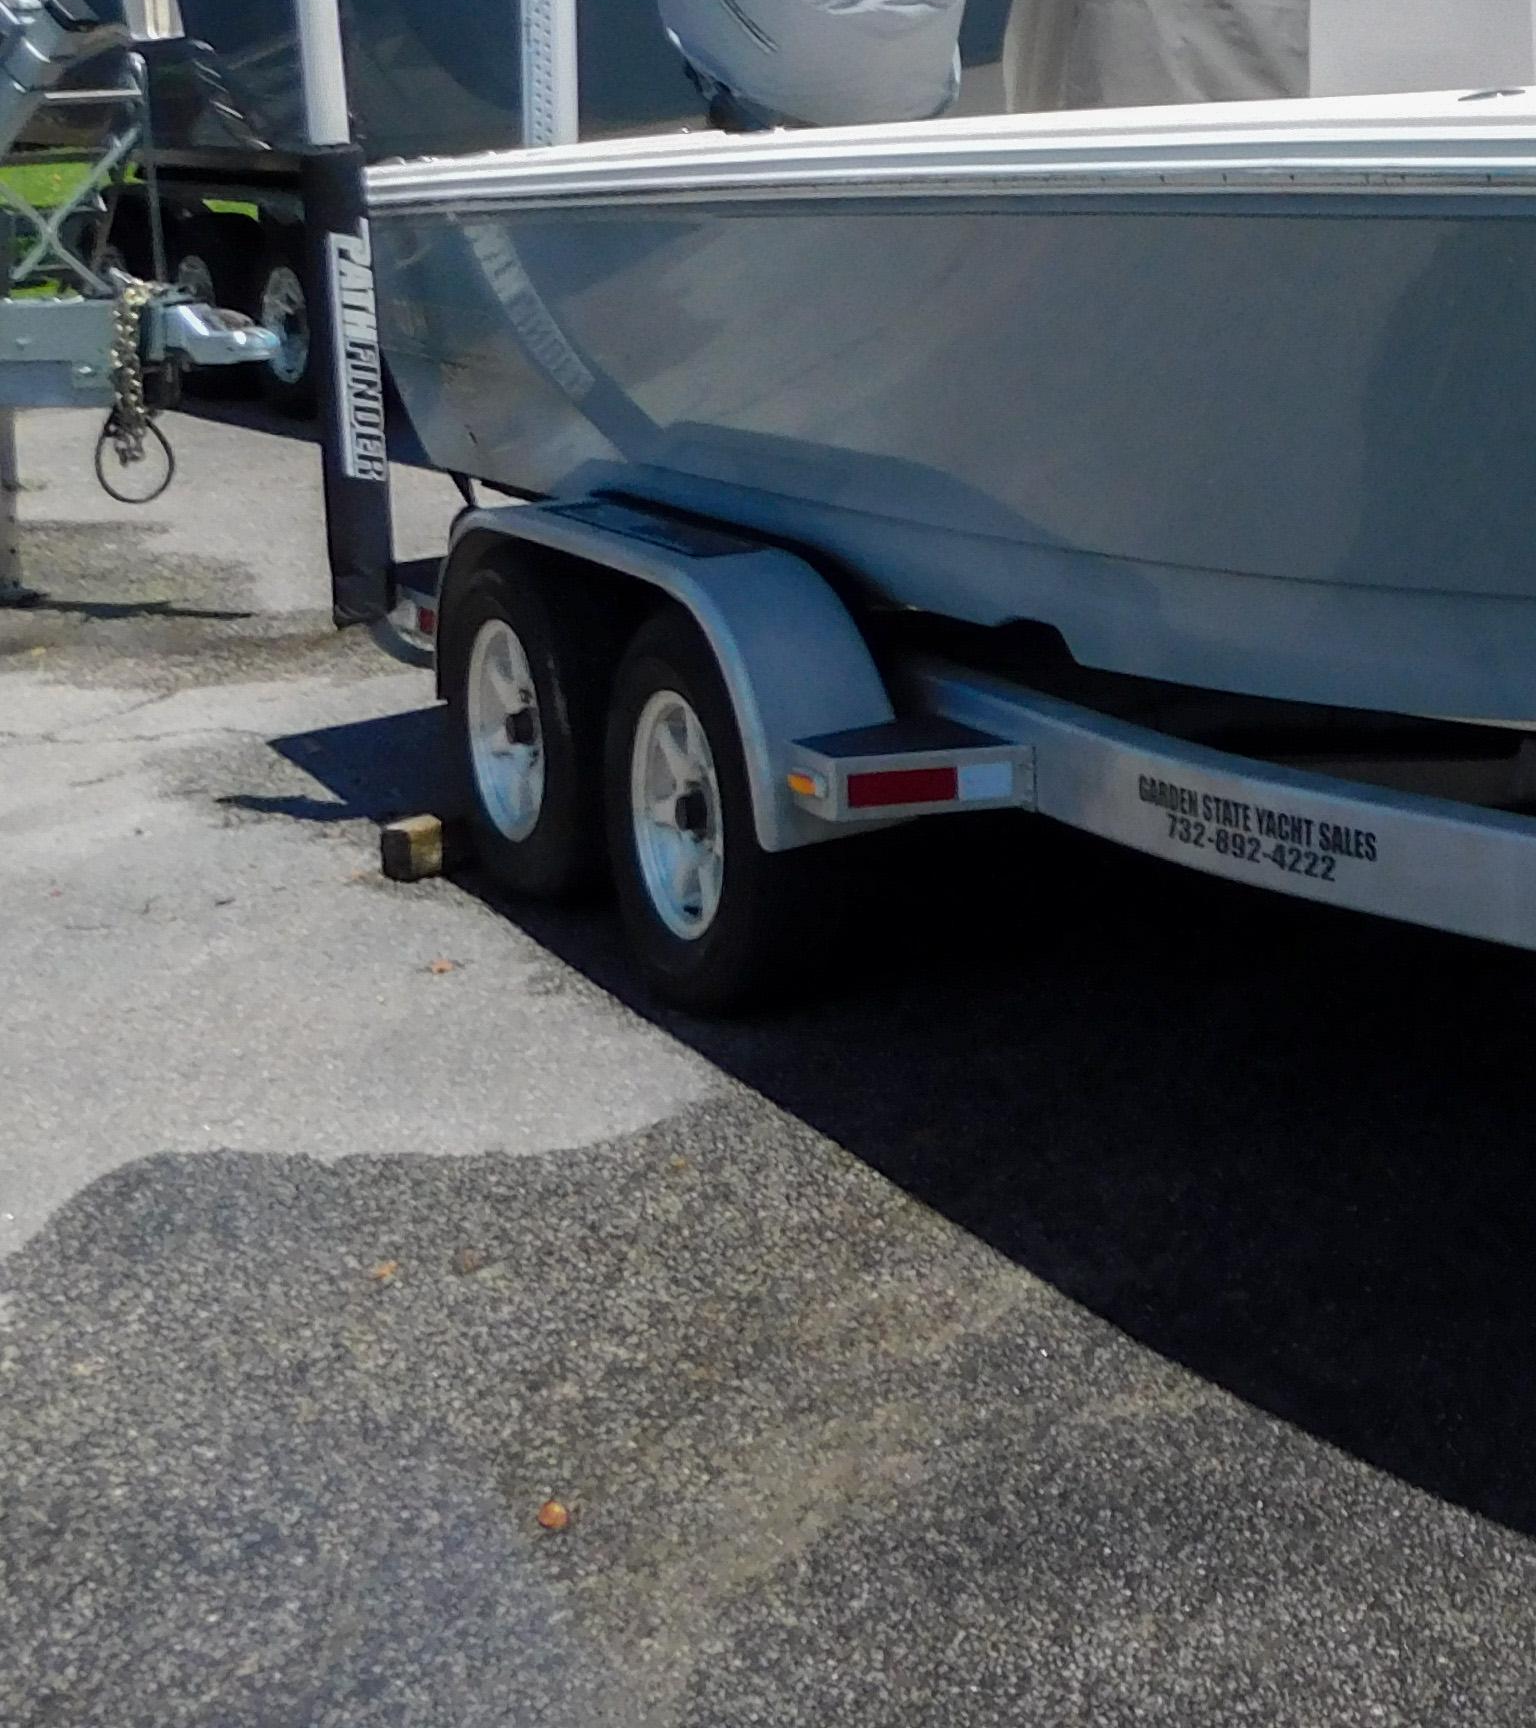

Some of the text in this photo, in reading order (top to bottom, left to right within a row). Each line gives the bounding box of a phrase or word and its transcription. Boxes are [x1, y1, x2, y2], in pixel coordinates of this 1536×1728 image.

[324, 216, 387, 481] PATHFINDER
[1138, 774, 1377, 861] GARDEN STATE YACHT SALES
